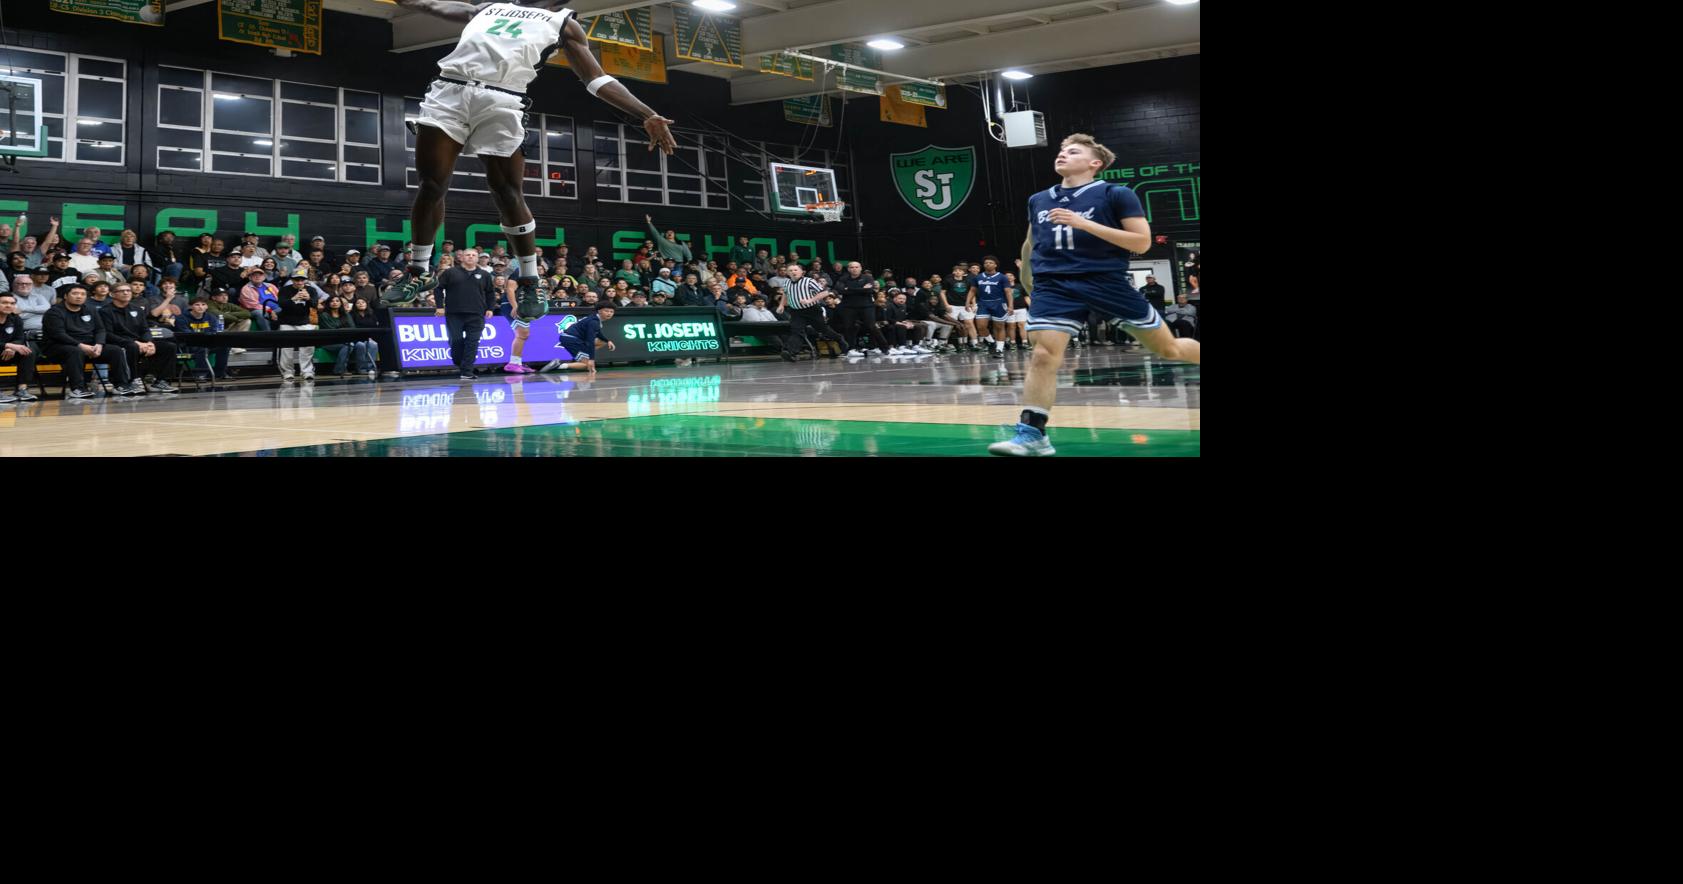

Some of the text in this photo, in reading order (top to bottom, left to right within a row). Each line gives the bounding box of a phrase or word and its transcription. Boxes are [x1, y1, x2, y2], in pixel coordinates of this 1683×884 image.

[486, 18, 523, 38] 24
[932, 153, 968, 165] ARE
[1093, 167, 1135, 180] OME
[1139, 165, 1169, 177] OF
[1051, 224, 1074, 250] 11
[612, 230, 849, 266] SHOOL
[984, 285, 992, 294] 4
[398, 323, 497, 342] BULLD
[647, 339, 719, 352] KNIGHTS
[401, 346, 505, 361] KNITS
